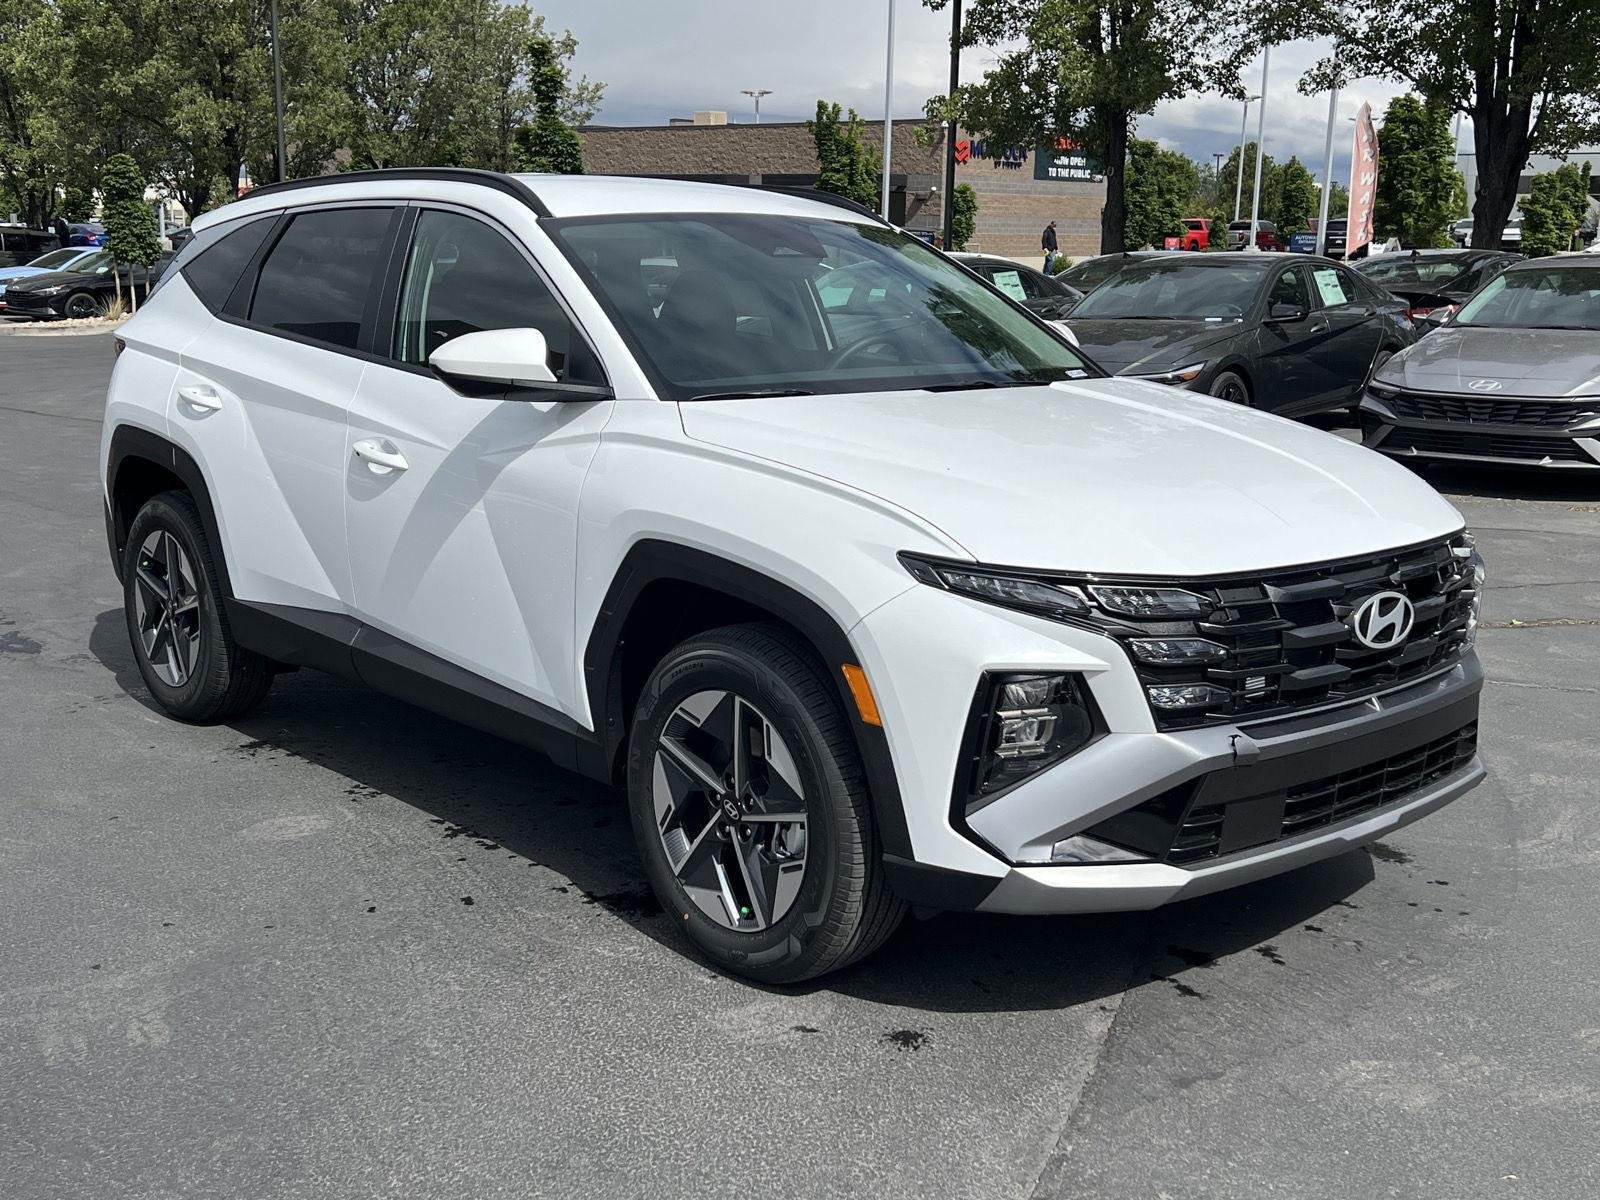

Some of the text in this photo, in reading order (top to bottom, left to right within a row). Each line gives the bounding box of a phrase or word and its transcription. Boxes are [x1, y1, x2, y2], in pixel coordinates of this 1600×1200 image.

[1070, 156, 1086, 166] OPEN
[1048, 167, 1091, 178] TO THE PUBLIC
